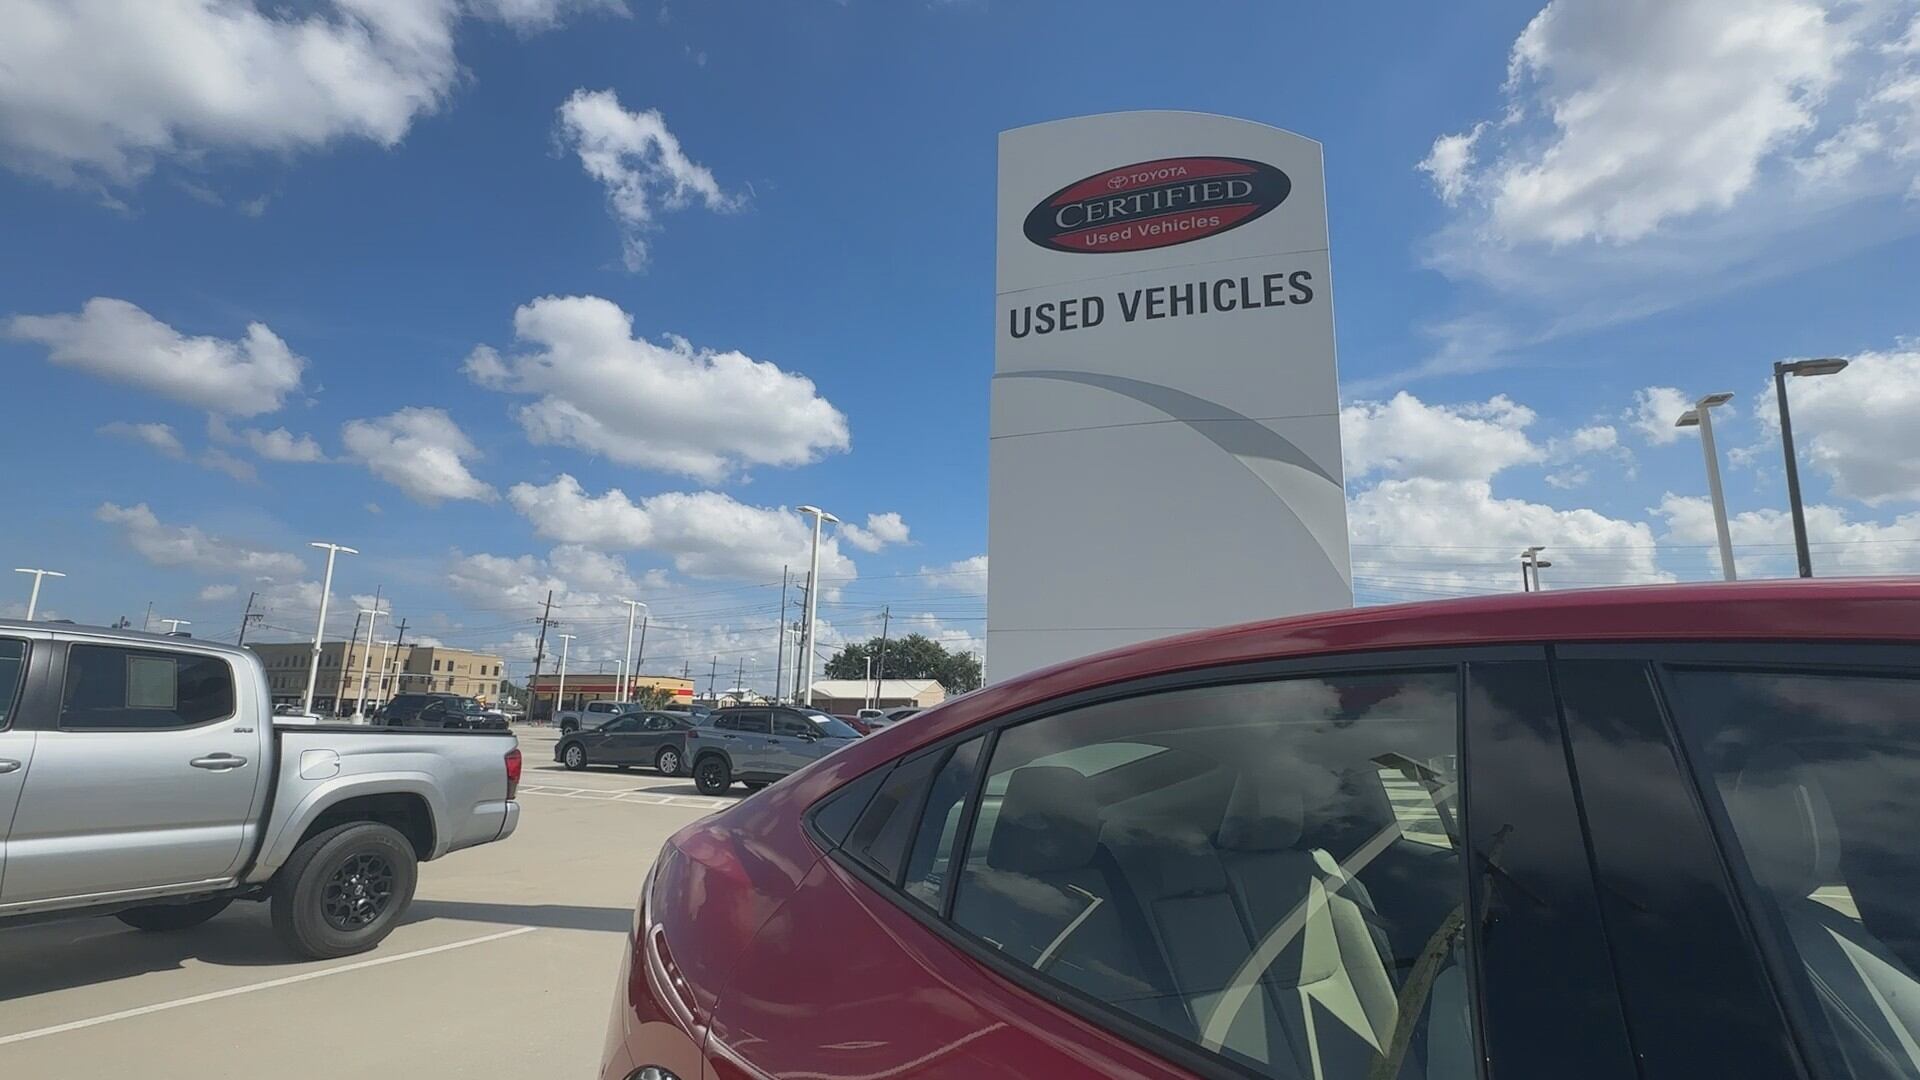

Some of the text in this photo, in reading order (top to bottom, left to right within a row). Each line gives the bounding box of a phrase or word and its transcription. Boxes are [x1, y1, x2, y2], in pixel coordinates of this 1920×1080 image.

[1129, 166, 1188, 185] TOYOTA
[1055, 180, 1253, 229] CERTIFIED
[1086, 215, 1220, 246] Used Vehicles
[1009, 270, 1314, 339] USED VEHICLES
